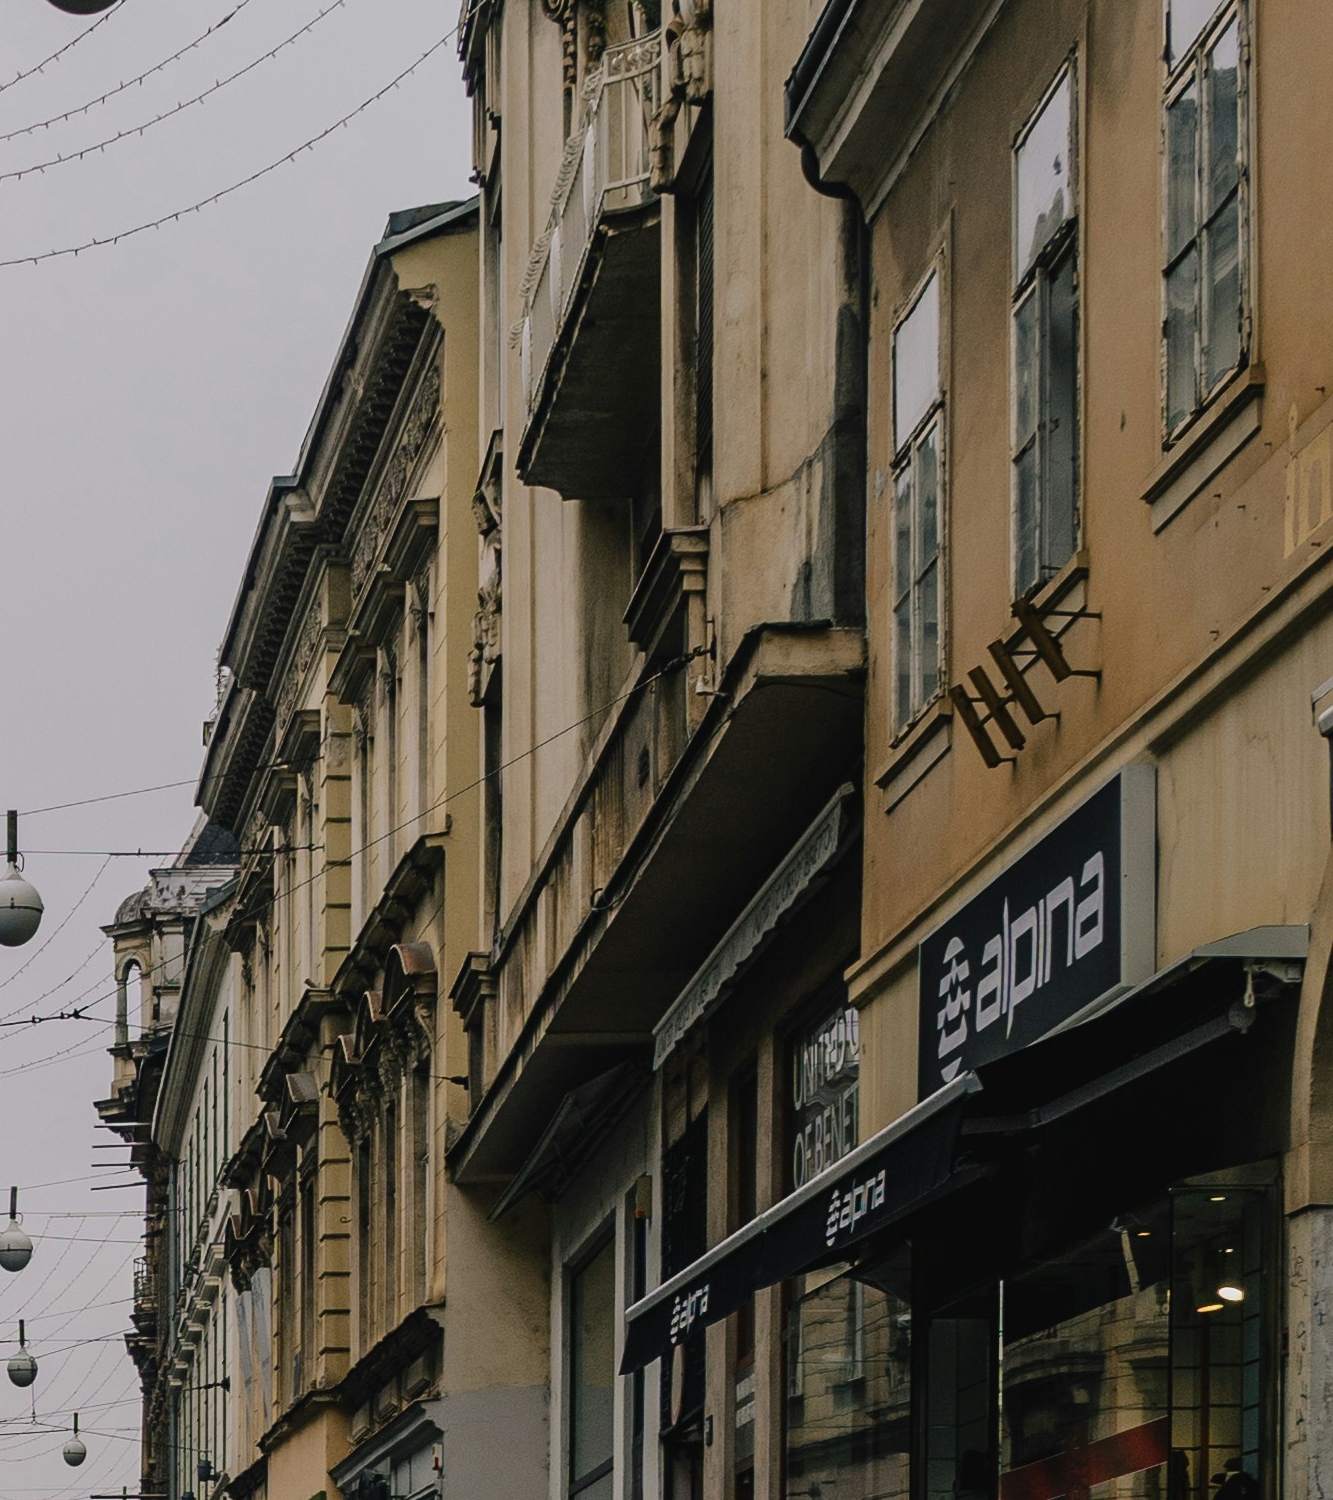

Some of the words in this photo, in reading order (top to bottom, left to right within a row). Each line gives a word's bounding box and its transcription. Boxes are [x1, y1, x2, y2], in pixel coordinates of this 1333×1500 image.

[975, 850, 1104, 1041] alpina
[793, 1007, 847, 1111] UNITED
[793, 1122, 812, 1190] OF
[839, 1169, 886, 1234] alpina
